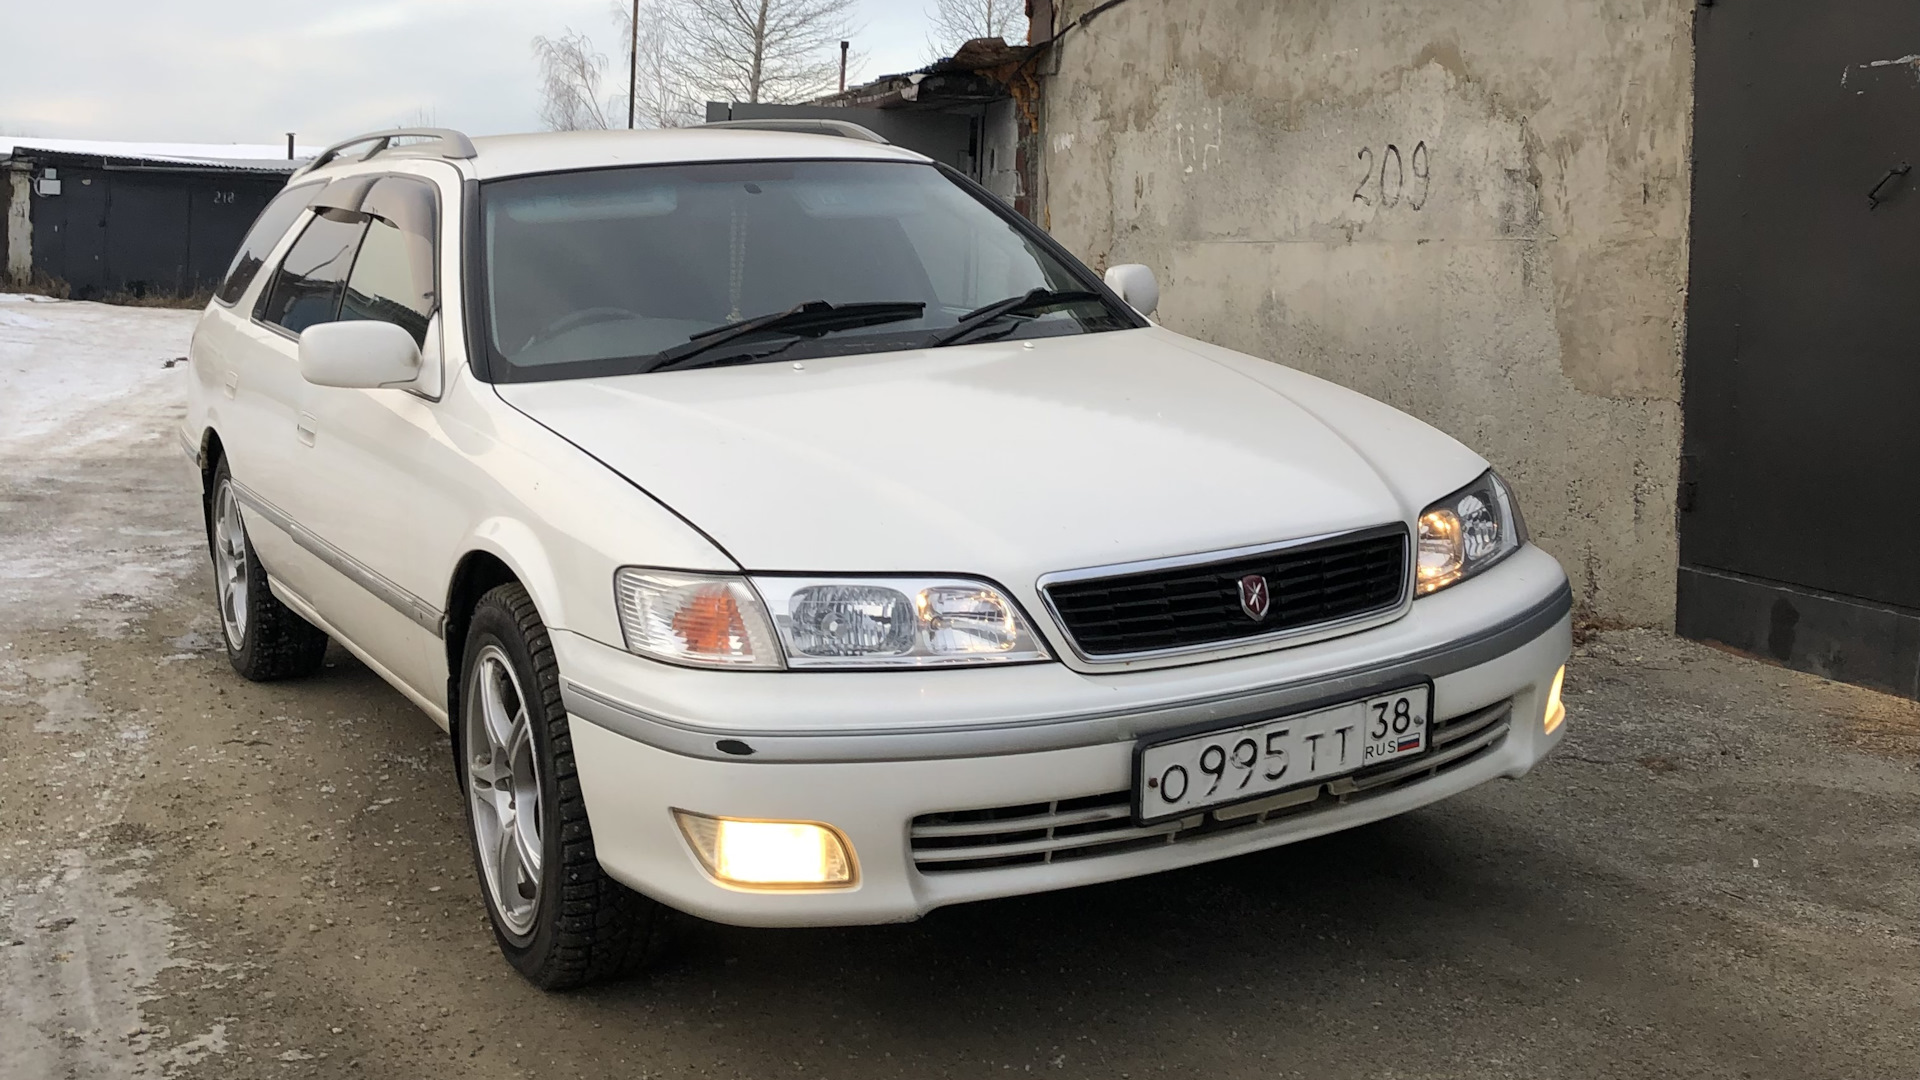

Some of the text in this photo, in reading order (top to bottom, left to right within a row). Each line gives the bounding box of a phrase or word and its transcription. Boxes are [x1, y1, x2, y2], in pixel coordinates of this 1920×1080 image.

[1353, 140, 1430, 211] 209
[1371, 697, 1411, 741] 38
[1365, 740, 1396, 760] RUS
